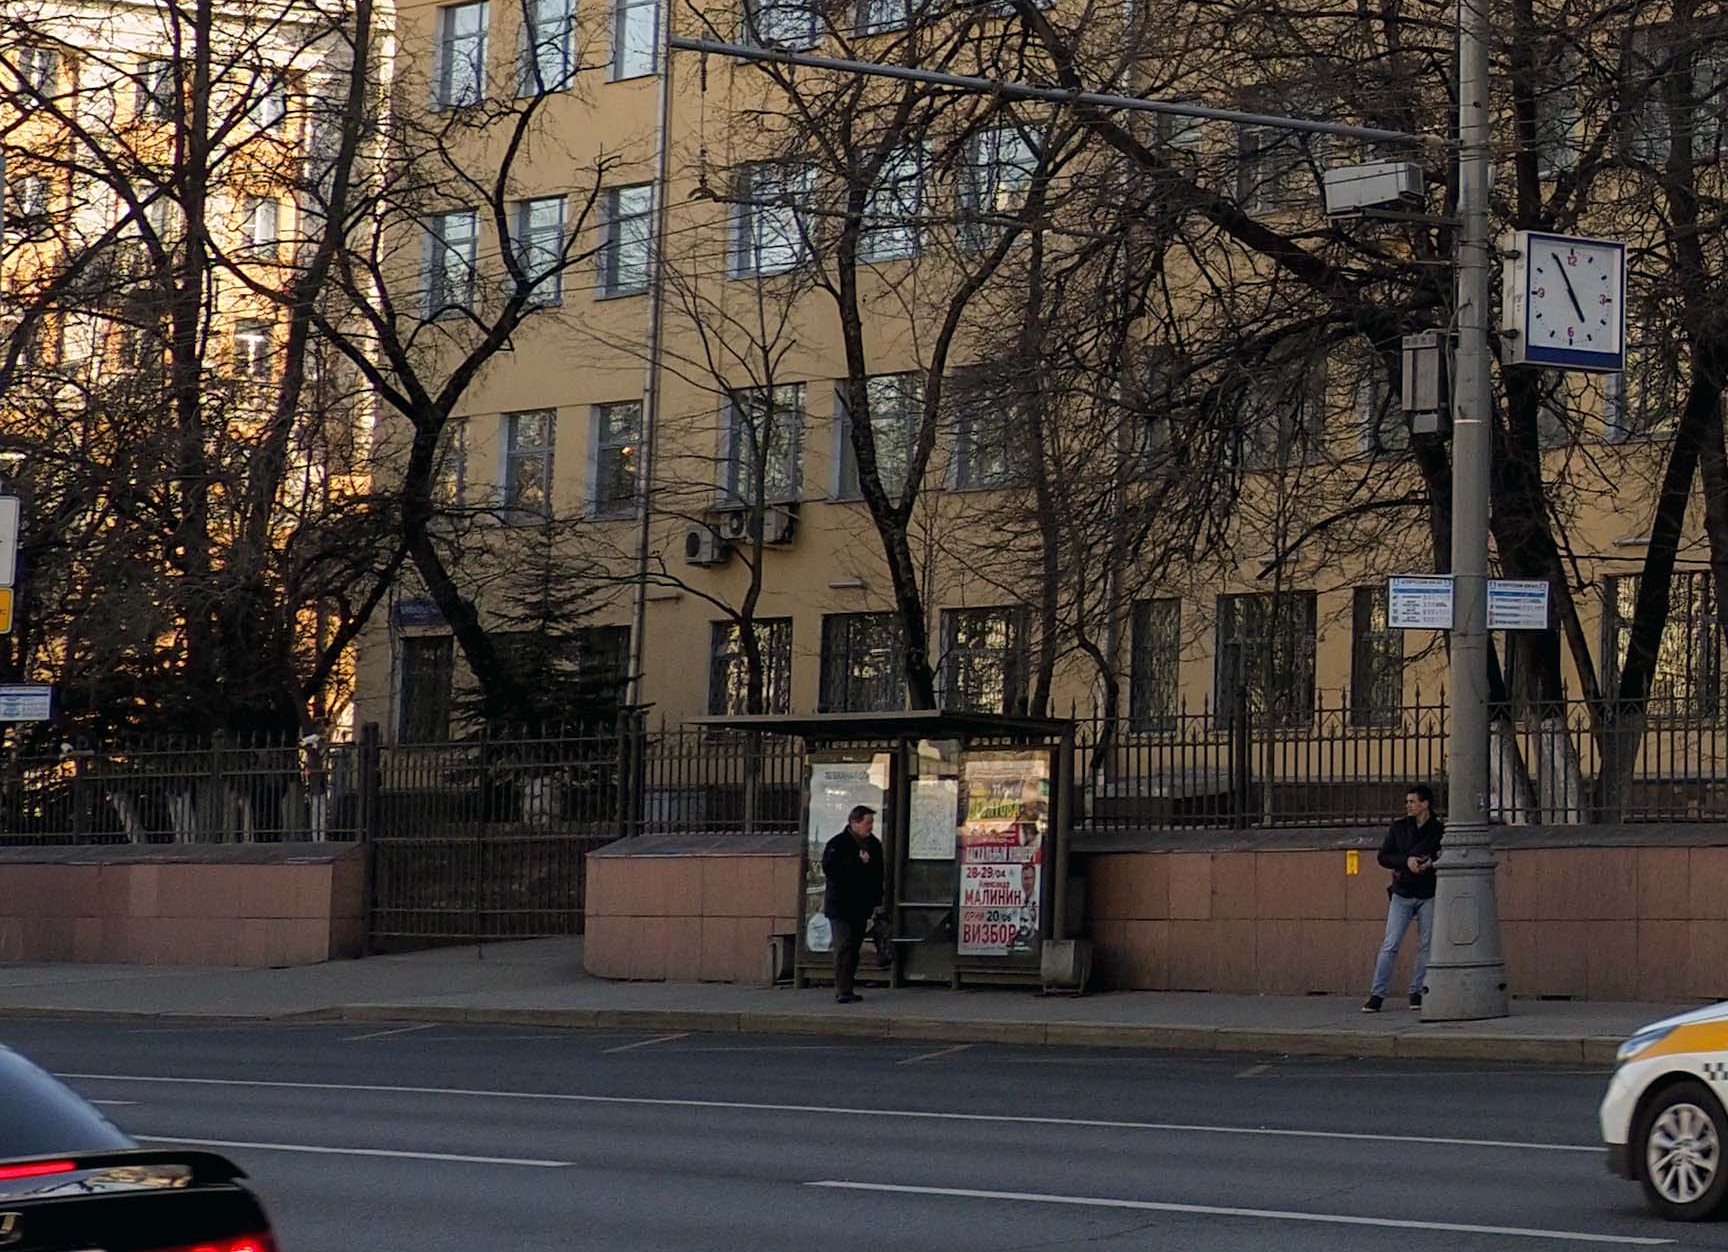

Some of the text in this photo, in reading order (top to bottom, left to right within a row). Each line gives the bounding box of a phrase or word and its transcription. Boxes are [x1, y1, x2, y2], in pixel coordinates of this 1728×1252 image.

[1567, 255, 1578, 267] 12
[1599, 294, 1607, 306] 3
[1567, 326, 1575, 338] 6
[964, 890, 1022, 906] МАЛИНИН
[963, 923, 1017, 944] ВИЗБОР
